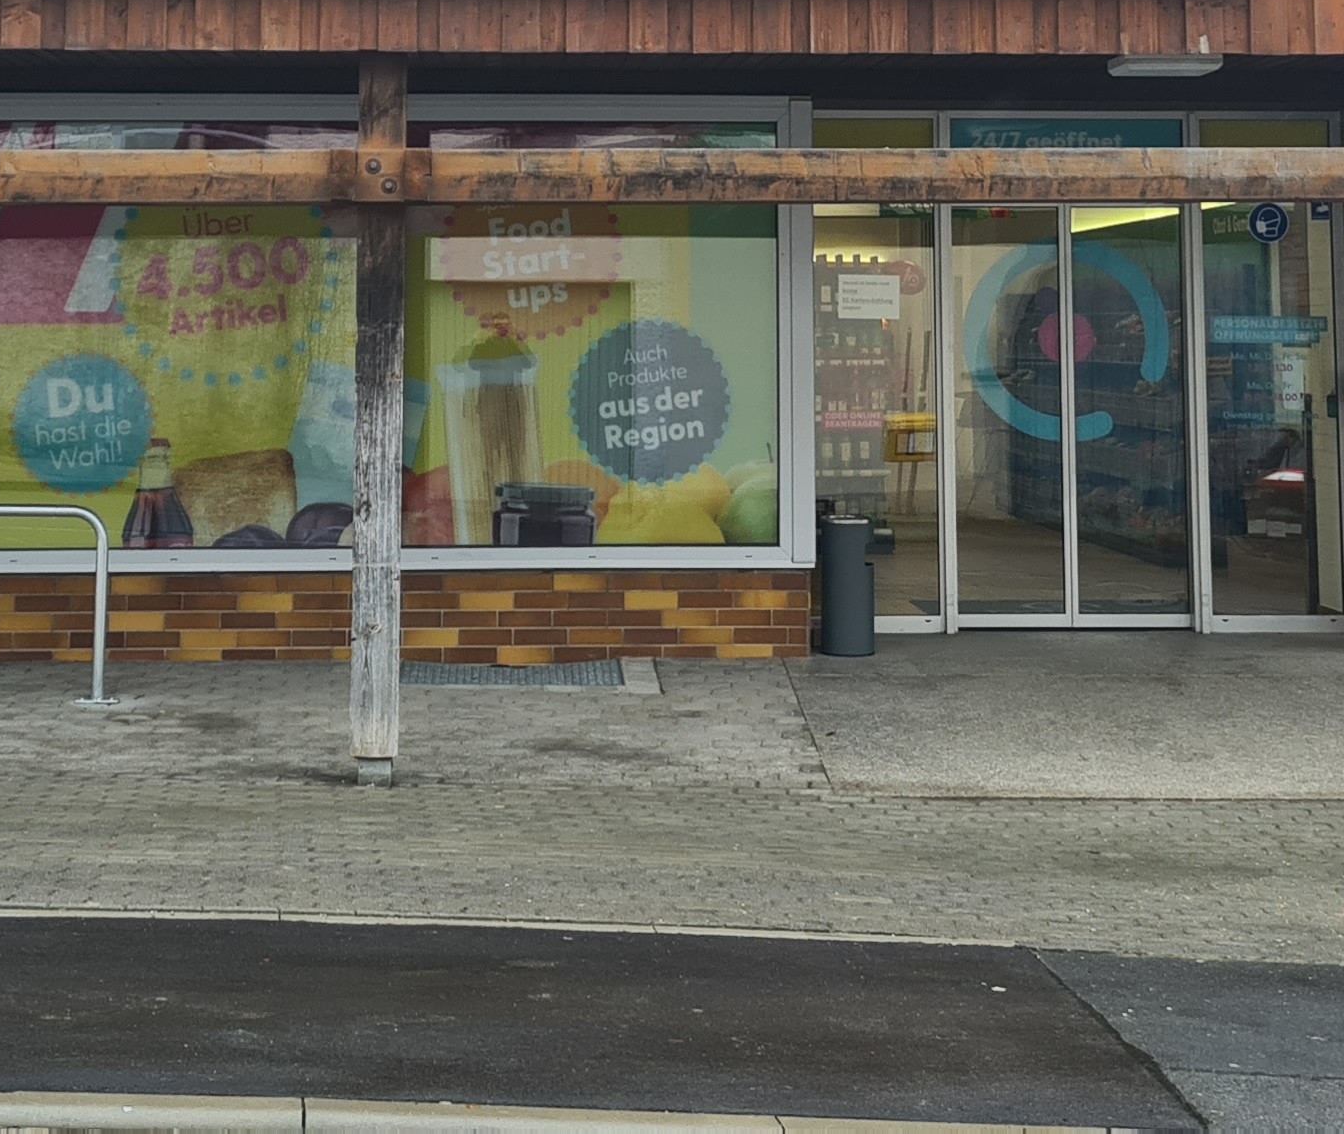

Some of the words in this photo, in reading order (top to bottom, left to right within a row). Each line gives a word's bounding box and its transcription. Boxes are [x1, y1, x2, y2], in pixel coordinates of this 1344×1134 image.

[971, 131, 1021, 148] 24/7
[182, 207, 254, 238] Über
[487, 207, 572, 247] Food
[137, 236, 311, 301] 4.500
[482, 243, 586, 279] Start-
[507, 282, 568, 313] ups
[168, 294, 289, 336] Artikel
[623, 344, 668, 365] Auch
[607, 366, 688, 388] Produkte
[46, 377, 116, 419] Du
[598, 396, 650, 419] aus
[654, 385, 704, 412] der
[34, 418, 87, 448] hast
[94, 416, 132, 439] die
[604, 416, 705, 451] Region
[48, 443, 123, 470] Wahl!
